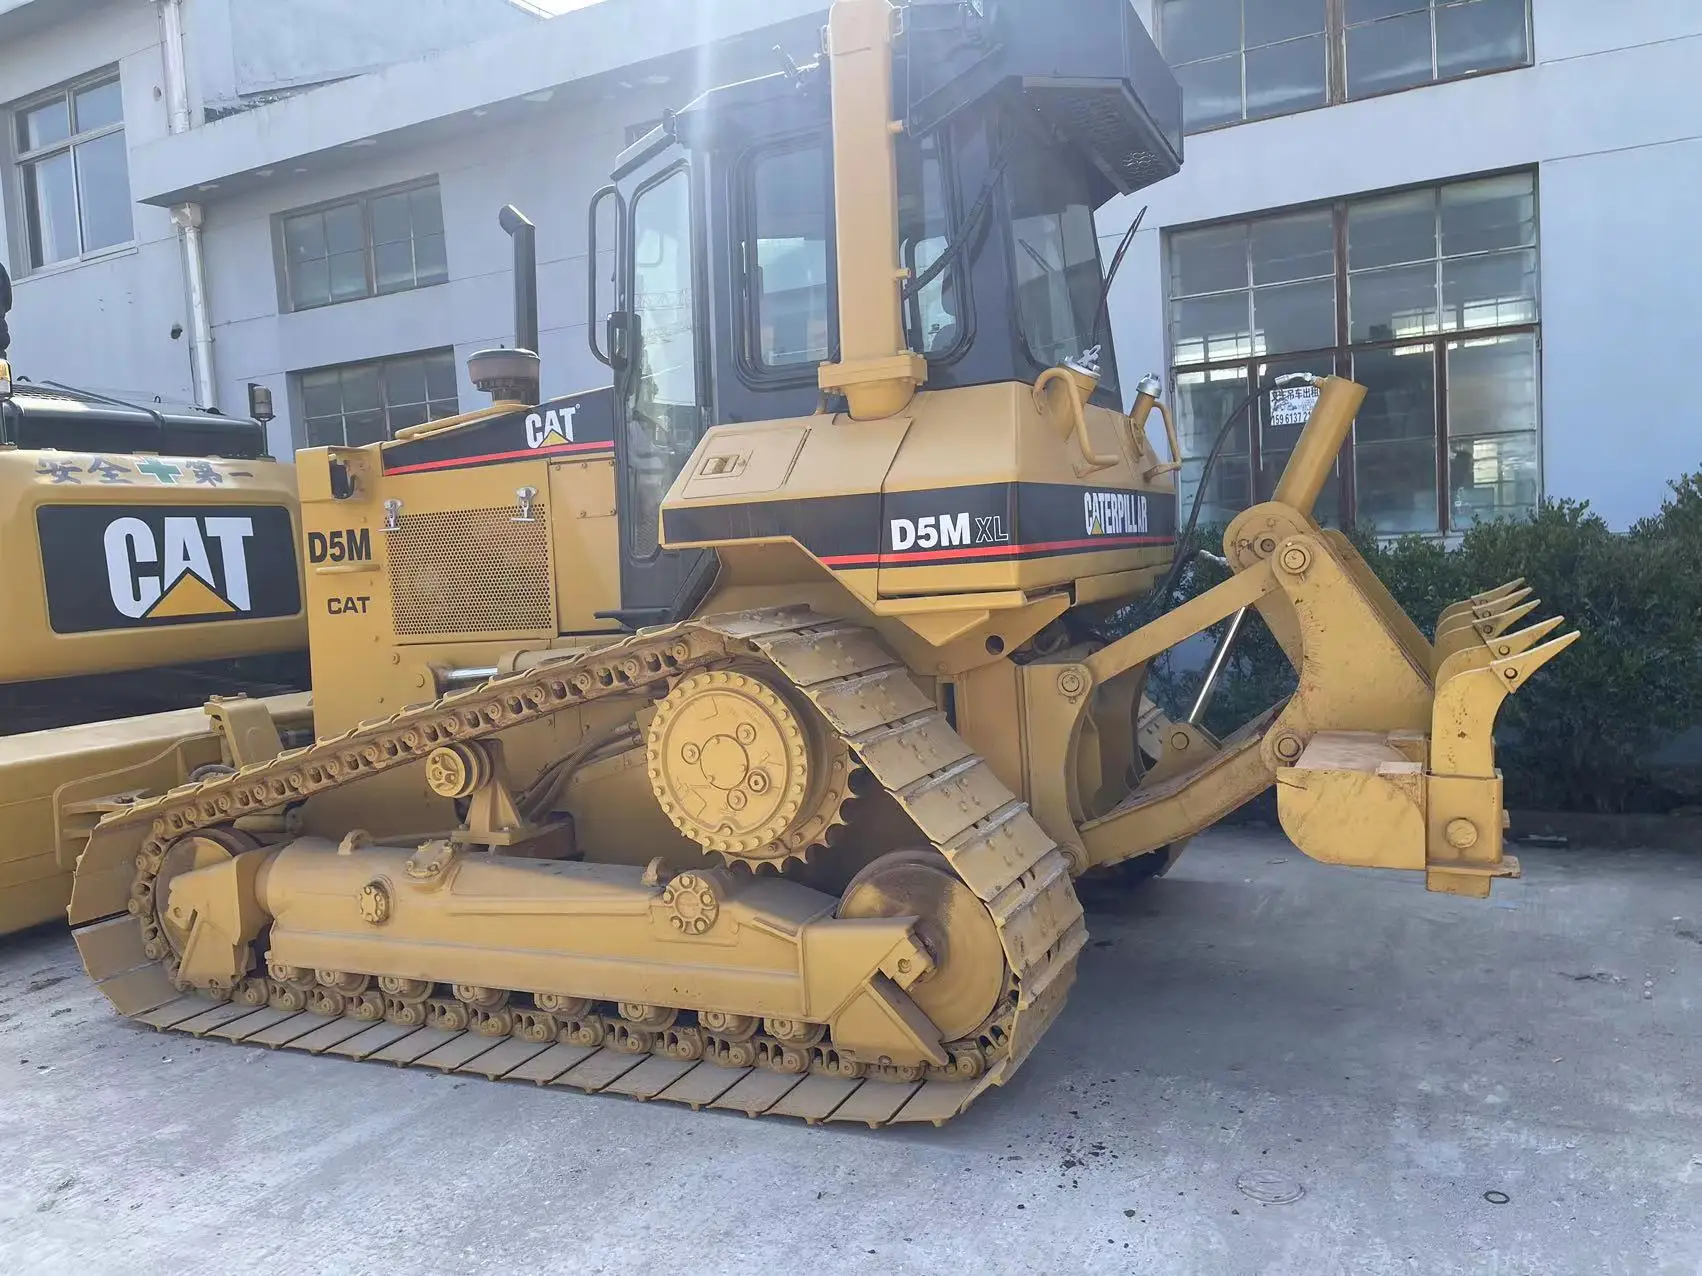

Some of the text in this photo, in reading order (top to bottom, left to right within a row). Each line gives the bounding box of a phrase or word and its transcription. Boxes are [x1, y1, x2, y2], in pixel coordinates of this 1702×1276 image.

[1285, 412, 1302, 423] 6137
[890, 512, 1009, 551] D5M XL
[1083, 492, 1149, 536] CATERPILLAR
[307, 528, 373, 563] D5M
[103, 517, 255, 619] CAT
[327, 596, 371, 615] CAT
